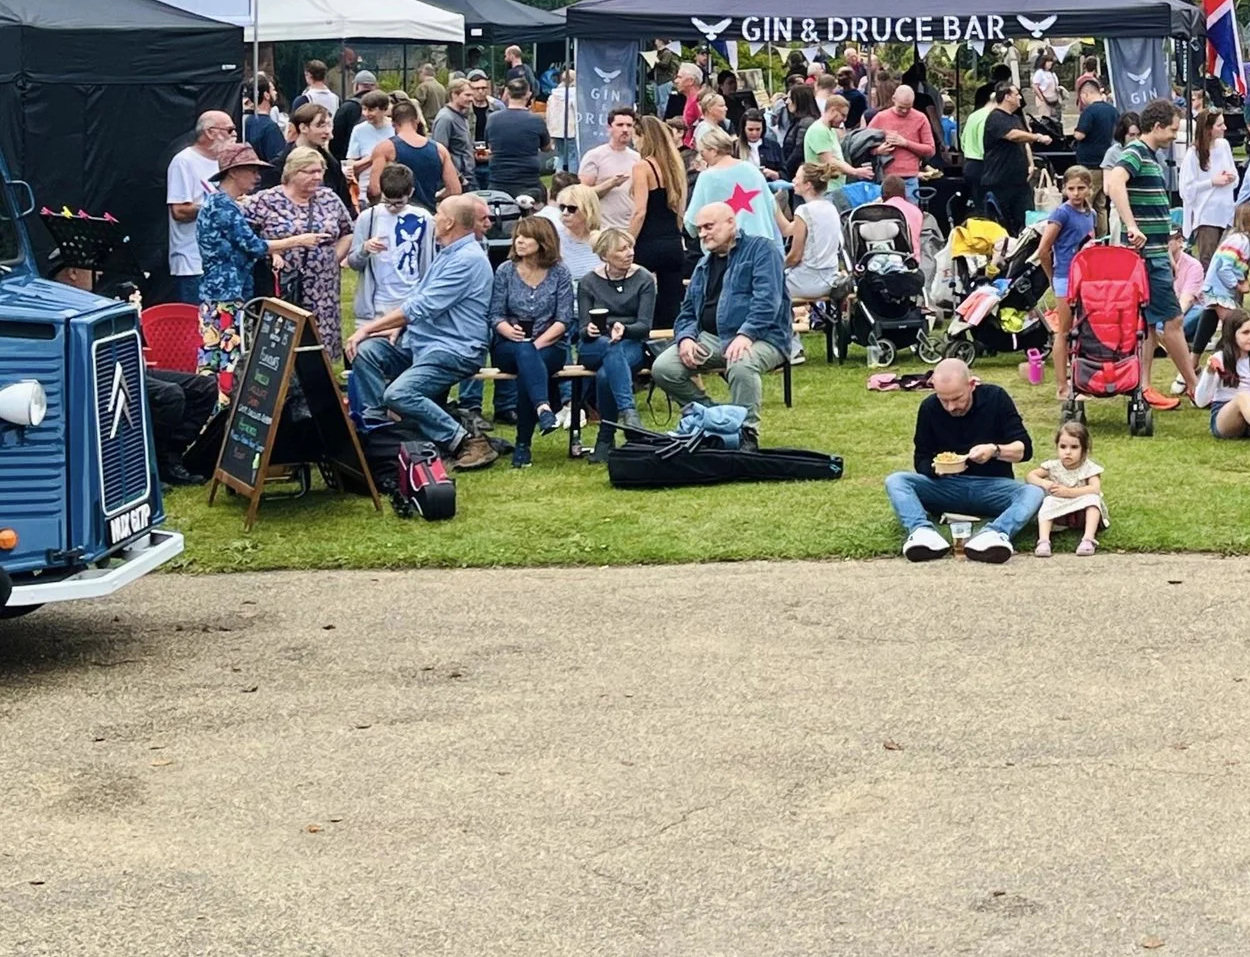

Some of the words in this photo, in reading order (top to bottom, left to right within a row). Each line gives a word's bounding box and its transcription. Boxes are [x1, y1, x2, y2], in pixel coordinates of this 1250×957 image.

[741, 16, 792, 43] GIN
[801, 18, 819, 42] &
[827, 16, 934, 43] DRUCE
[944, 14, 1005, 41] BAR
[590, 87, 620, 102] GIN
[1130, 87, 1158, 104] GIN
